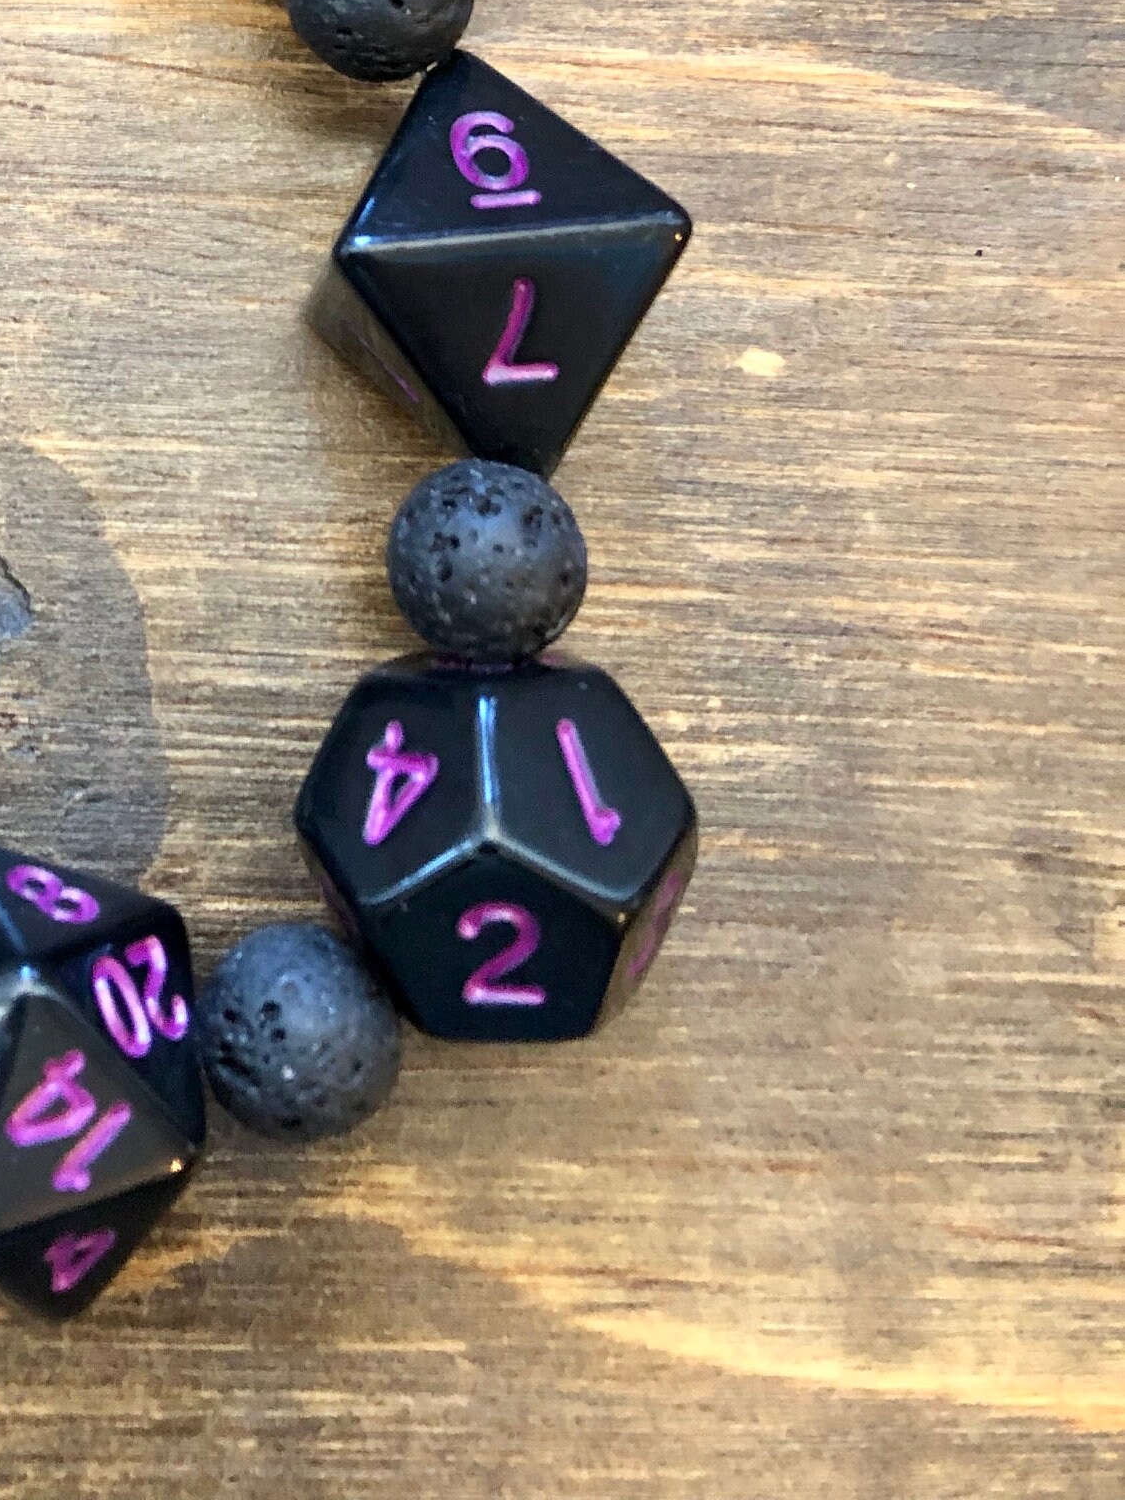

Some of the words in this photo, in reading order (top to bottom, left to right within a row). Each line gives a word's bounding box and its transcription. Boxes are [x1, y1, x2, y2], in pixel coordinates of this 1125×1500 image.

[481, 276, 561, 386] 7
[362, 719, 441, 847] 4
[555, 717, 622, 847] 1
[4, 863, 101, 925] 8
[456, 900, 548, 1006] 2
[91, 934, 190, 1060] 20
[4, 1048, 133, 1193] 14
[44, 1228, 118, 1295] 4
